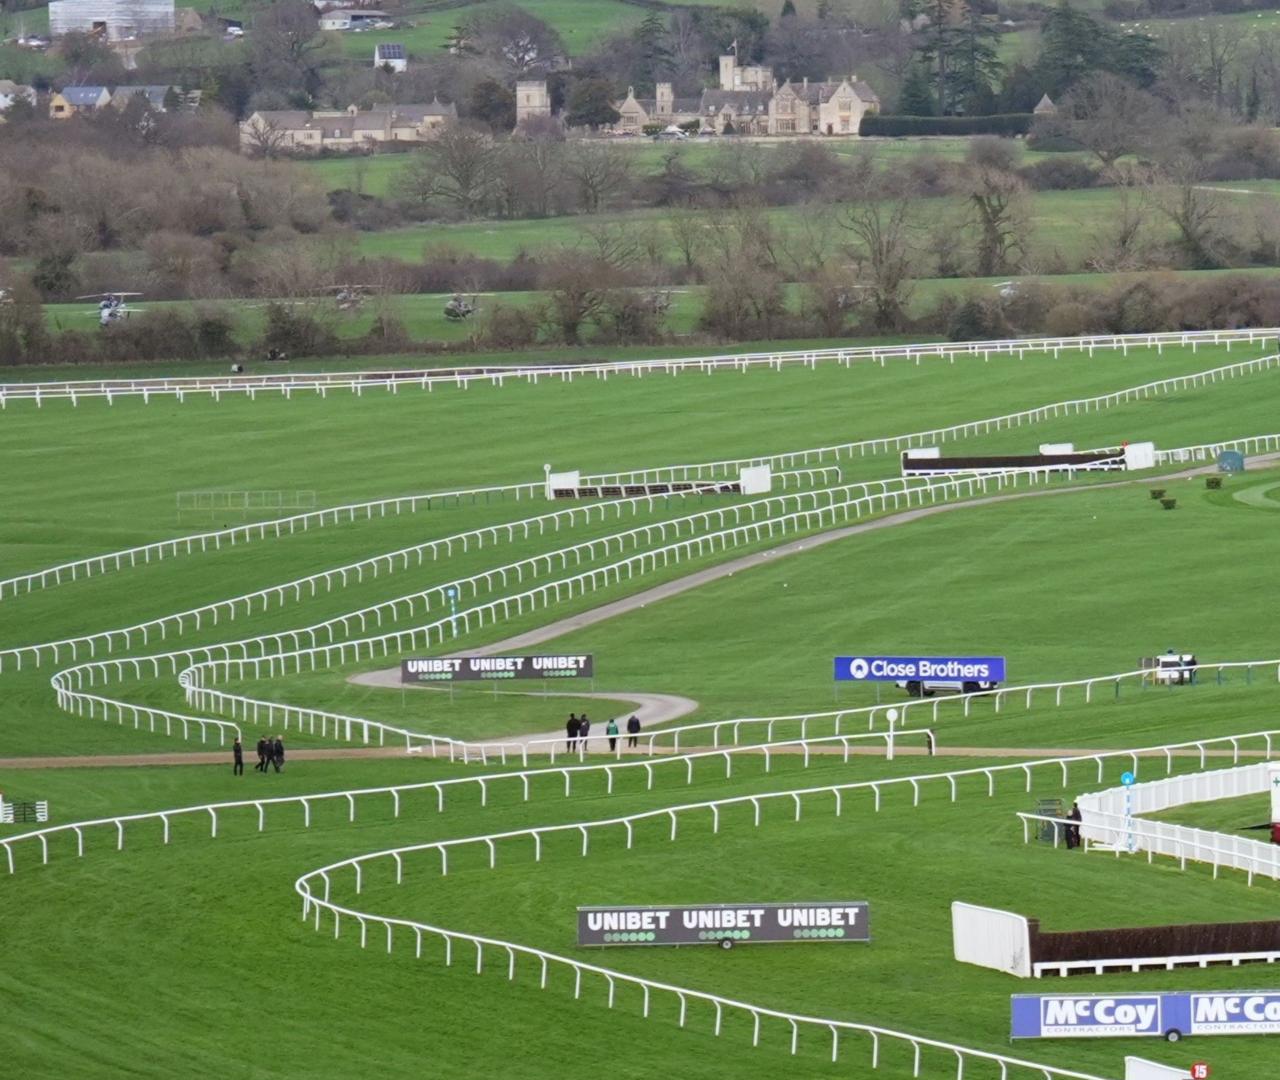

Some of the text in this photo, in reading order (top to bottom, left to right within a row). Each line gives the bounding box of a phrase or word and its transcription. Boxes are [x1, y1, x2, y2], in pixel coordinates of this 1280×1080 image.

[407, 656, 587, 673] UNIBET UNIBET UNIBET
[871, 660, 989, 677] Close Brothers
[587, 907, 859, 931] UNIBET UNIBET UNIBET
[1046, 1026, 1133, 1034] CONTRACTORS
[1194, 1064, 1207, 1079] 15
